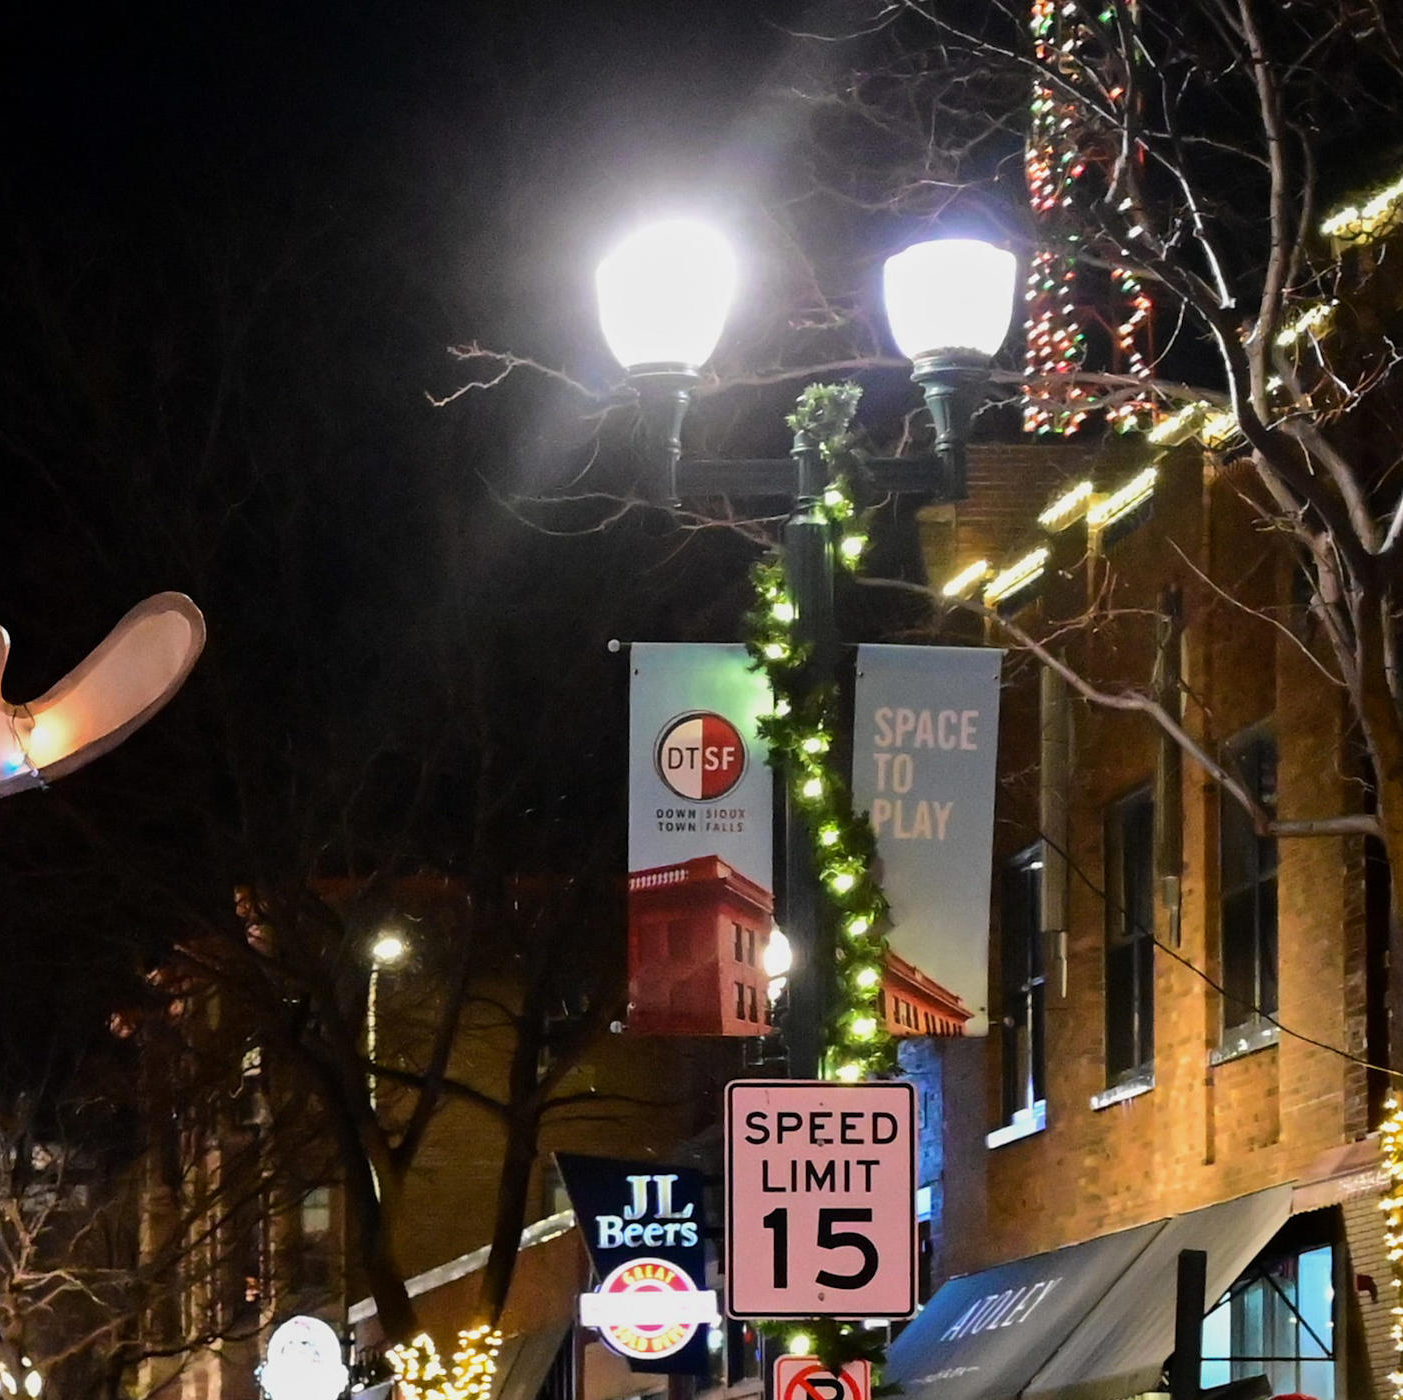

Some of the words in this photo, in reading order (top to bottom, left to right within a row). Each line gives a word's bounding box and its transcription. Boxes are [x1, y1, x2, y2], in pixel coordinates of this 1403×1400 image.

[873, 706, 980, 751] SPACE
[667, 746, 736, 771] DTSF
[872, 752, 914, 795] TO
[656, 808, 696, 819] DOWN
[658, 822, 696, 832] TOWN
[705, 808, 746, 819] SIOUX
[705, 822, 744, 833] FALLS
[872, 799, 954, 840] PLAY
[744, 1111, 899, 1146] SPEED
[761, 1159, 881, 1193] LIMIT
[623, 1174, 694, 1220] JL
[595, 1214, 699, 1249] Beers
[762, 1207, 880, 1290] 15
[621, 1266, 676, 1285] GREAT
